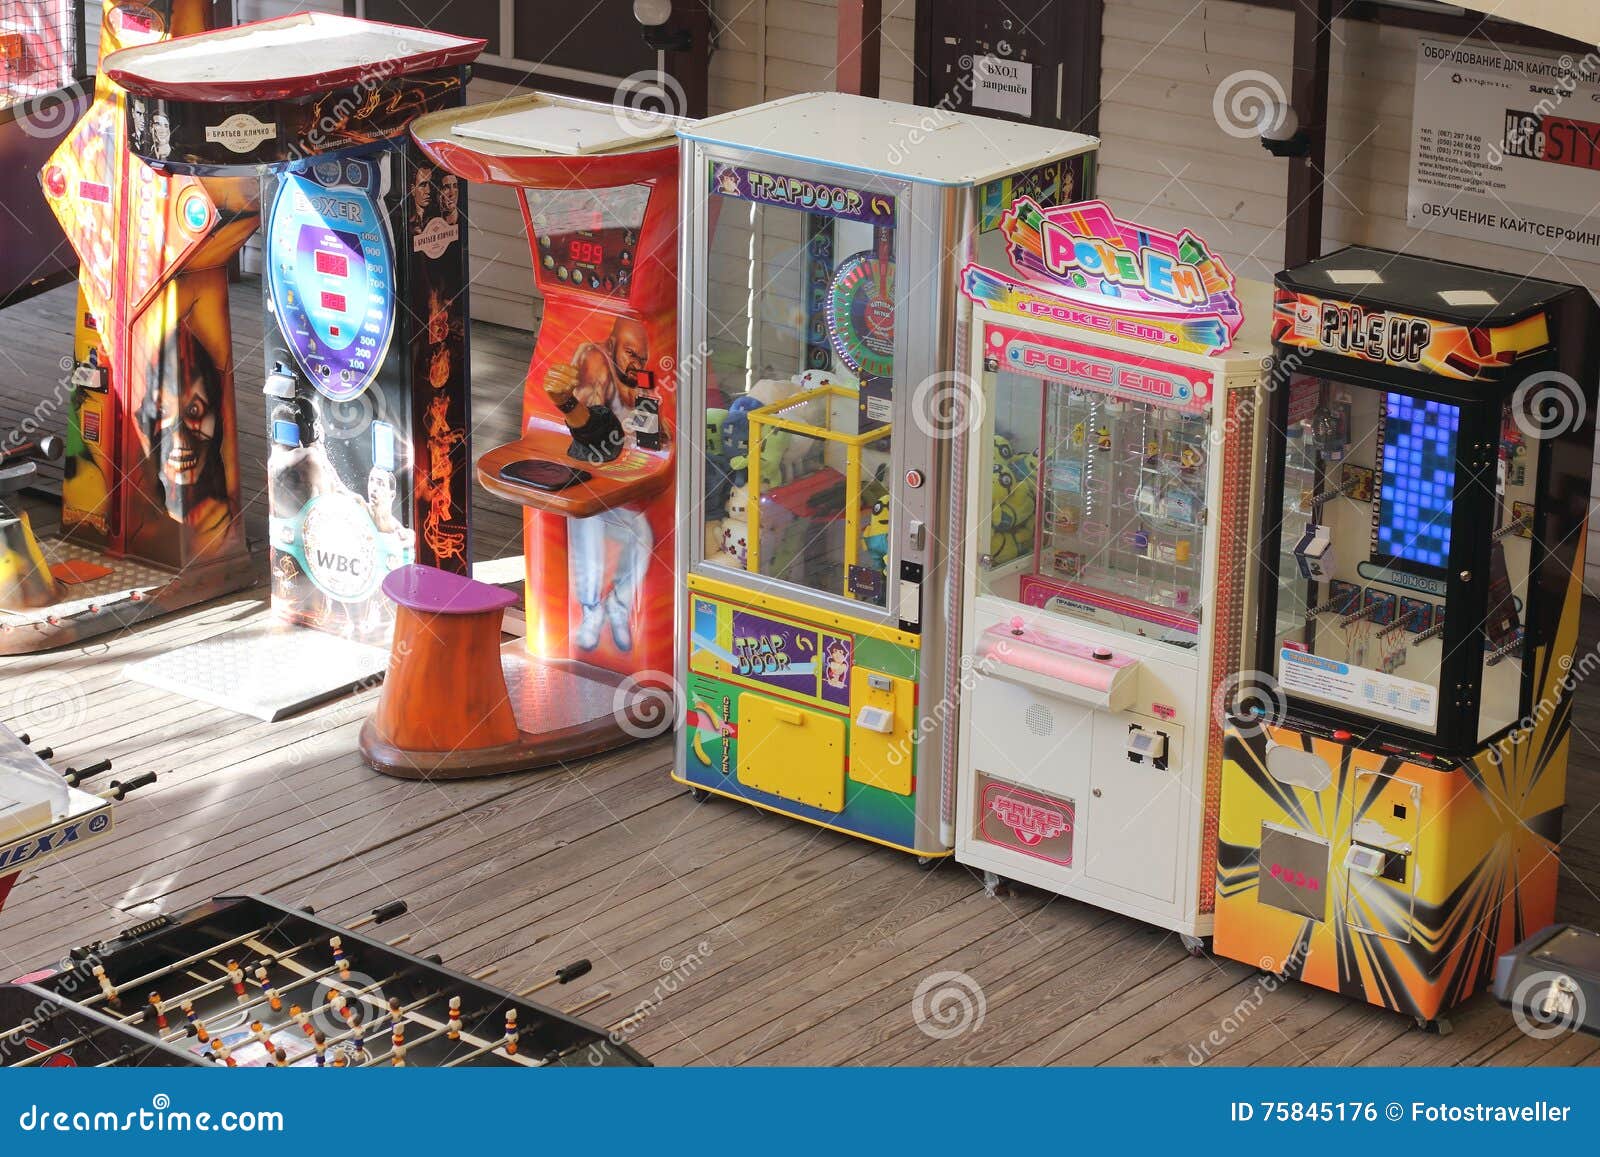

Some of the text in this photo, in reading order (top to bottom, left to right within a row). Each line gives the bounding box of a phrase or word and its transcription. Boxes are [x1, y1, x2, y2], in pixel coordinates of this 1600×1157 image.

[987, 63, 1018, 79] ВХОД
[1424, 46, 1502, 69] ОБОРУДОВАНИЕ
[1504, 59, 1524, 73] ДЛЯ
[1526, 62, 1600, 84] КАЙТСЕРФИНГ
[747, 170, 864, 216] TRAPDOOR
[1421, 202, 1497, 227] ОБУЧЕНИЕ
[1045, 224, 1202, 303] POKE EM
[1030, 301, 1113, 331] POKE
[1320, 302, 1431, 364] PILE UP
[348, 359, 366, 370] 100
[354, 347, 372, 359] 200
[1024, 347, 1114, 384] POKE
[316, 549, 361, 577] WBC
[1391, 571, 1438, 592] MINOR
[734, 633, 786, 658] TRAP
[738, 651, 792, 677] DOOR
[721, 695, 731, 776] GET PRIZE
[996, 796, 1063, 828] PRIZE
[1006, 812, 1049, 835] OUT
